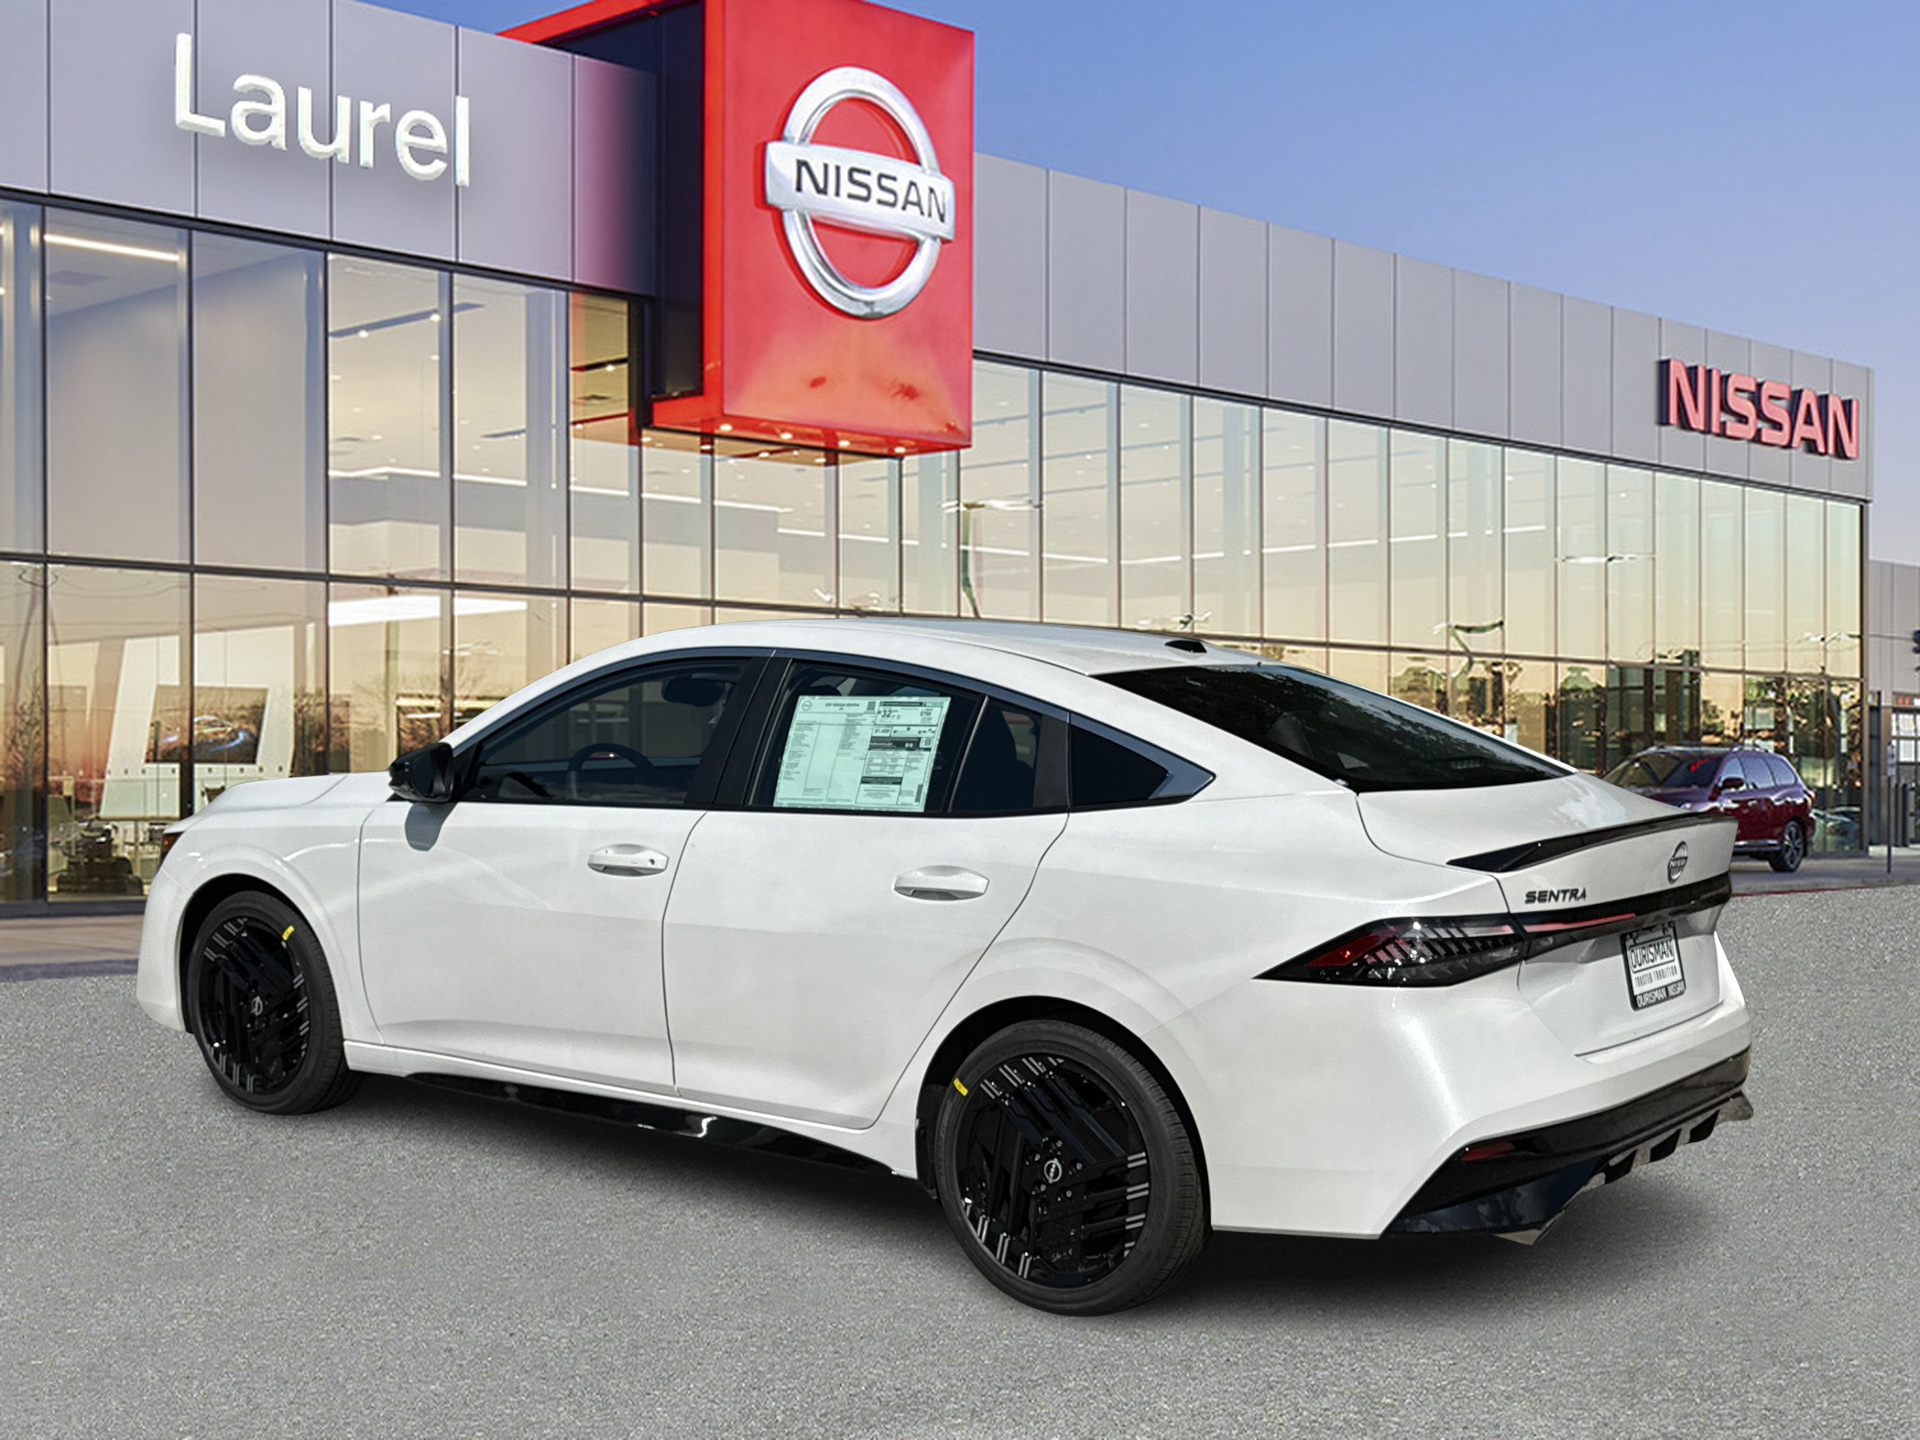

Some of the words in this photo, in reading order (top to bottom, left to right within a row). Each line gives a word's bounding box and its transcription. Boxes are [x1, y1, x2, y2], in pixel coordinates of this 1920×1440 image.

[175, 32, 470, 188] Laurel
[795, 158, 946, 223] NISSAN
[1657, 358, 1859, 459] NISSAN
[1525, 888, 1586, 904] SENTRA
[1630, 940, 1674, 969] OURISMAN
